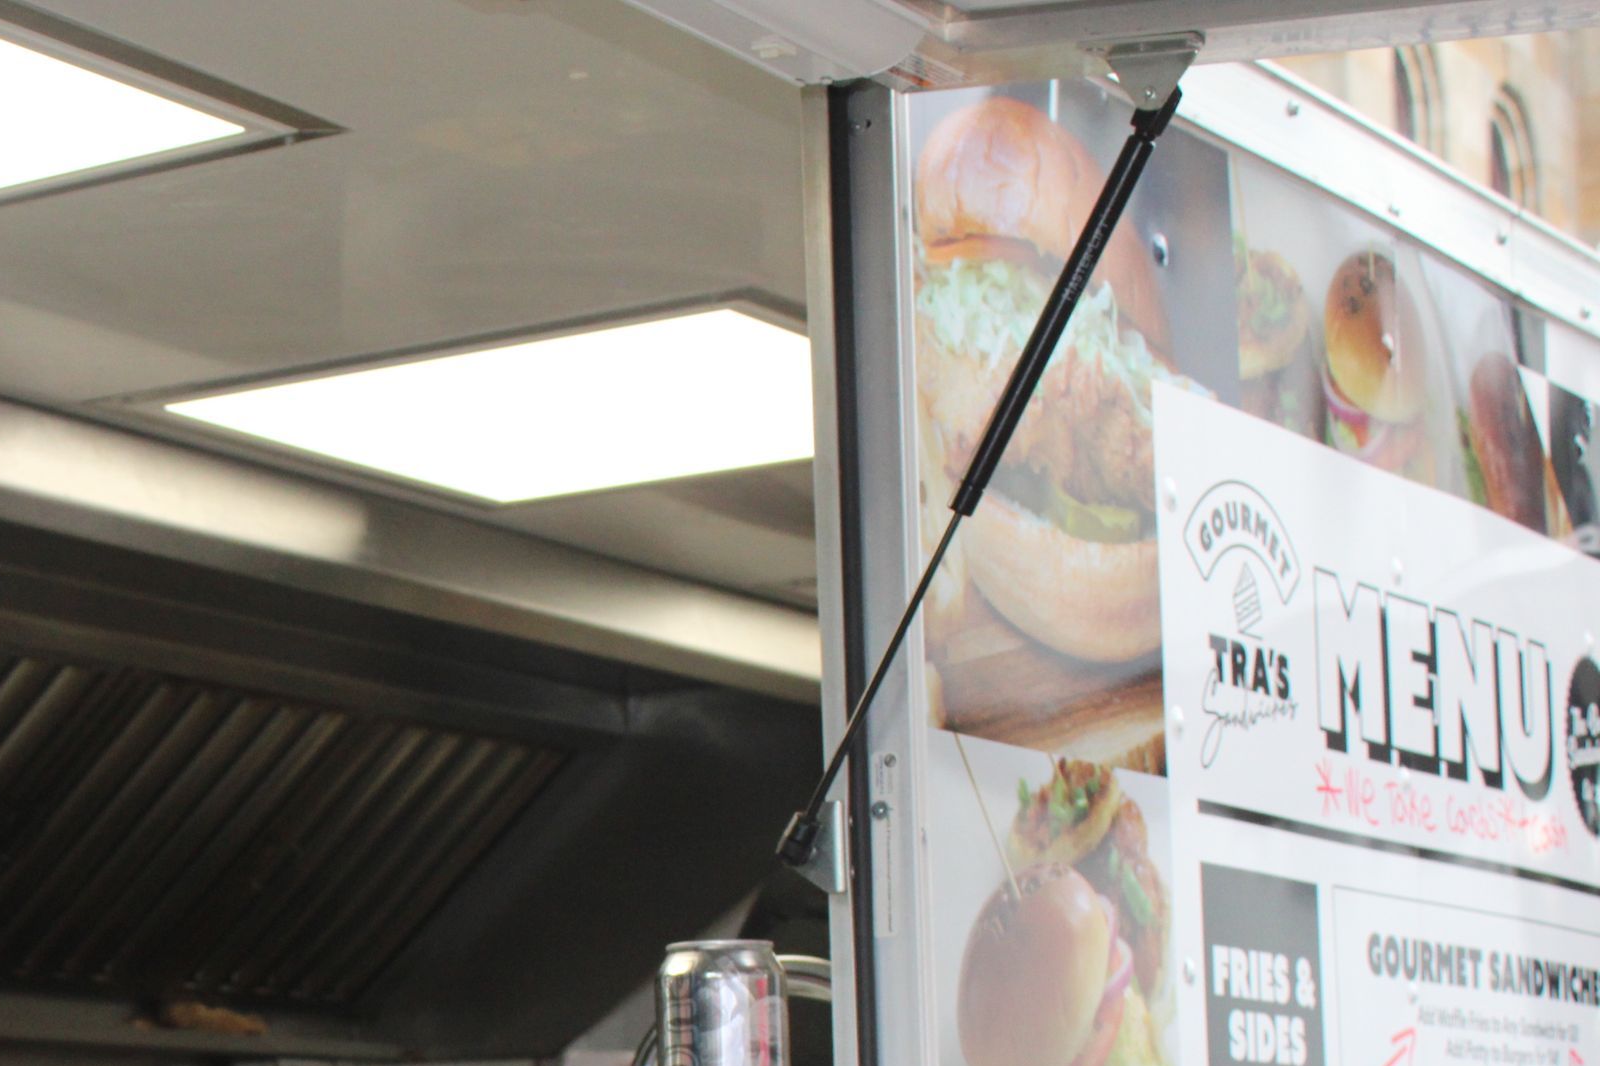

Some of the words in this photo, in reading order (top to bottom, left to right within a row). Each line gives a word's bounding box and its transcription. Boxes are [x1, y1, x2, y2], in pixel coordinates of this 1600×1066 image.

[1199, 502, 1291, 578] GOURMET
[1208, 633, 1291, 701] TRA'S
[1314, 566, 1555, 802] MENU
[1211, 944, 1291, 1004] FRIES
[1295, 957, 1316, 1010] &
[1366, 932, 1483, 990] GOURMET
[1489, 953, 1600, 1007] SANDWICHE
[1228, 1010, 1308, 1066] SIDES
